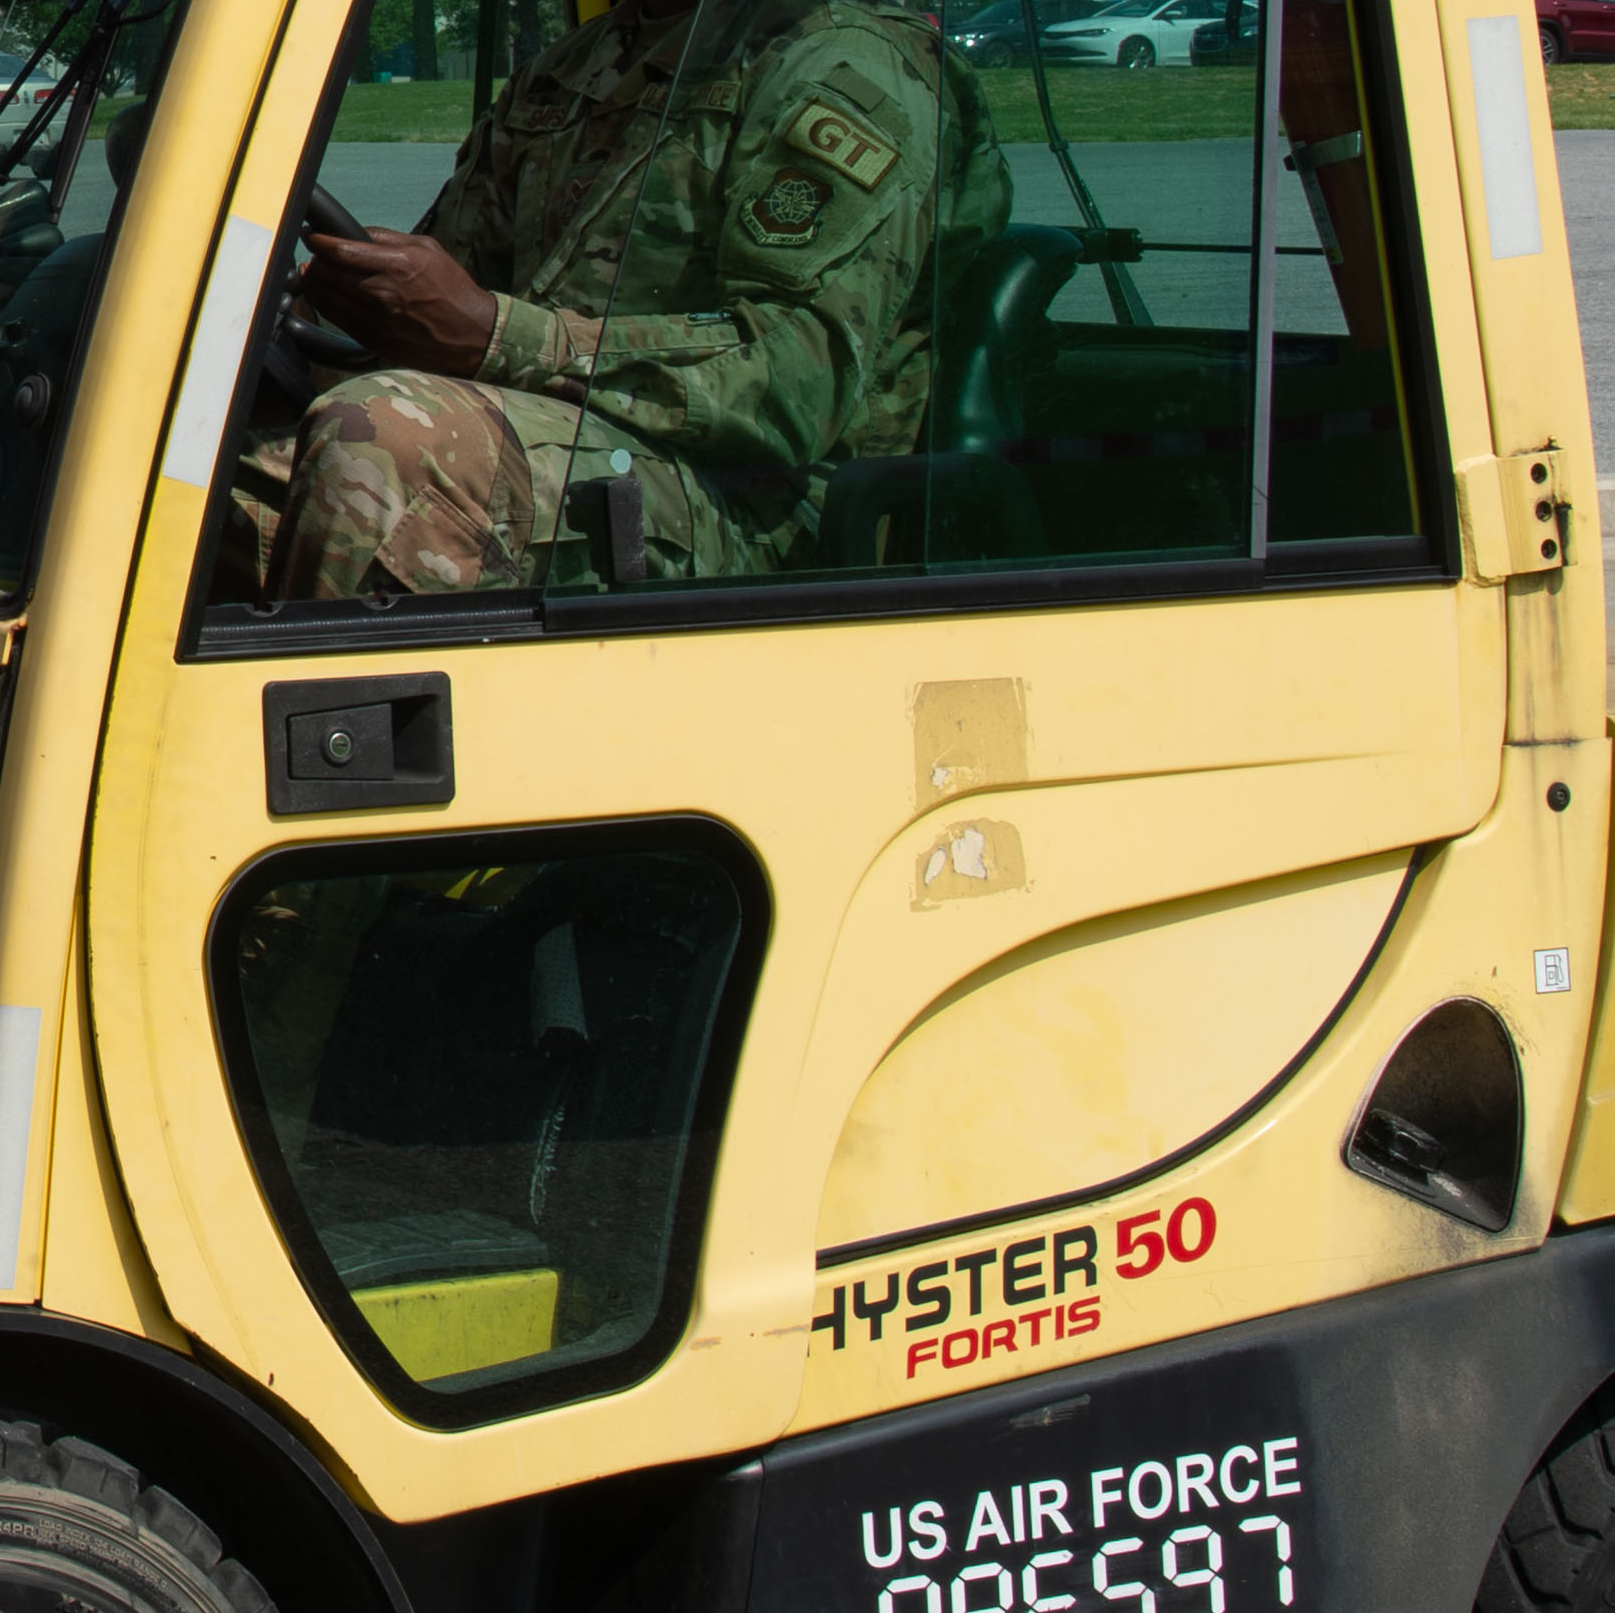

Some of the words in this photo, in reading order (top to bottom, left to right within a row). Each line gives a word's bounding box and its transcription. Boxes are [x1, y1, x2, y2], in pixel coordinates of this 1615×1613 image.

[809, 117, 881, 168] GT
[1116, 1197, 1217, 1279] 50
[906, 1295, 1101, 1379] FORTIS
[862, 1501, 948, 1568] US
[965, 1479, 1073, 1551] AIR
[1091, 1437, 1301, 1528] FORCE
